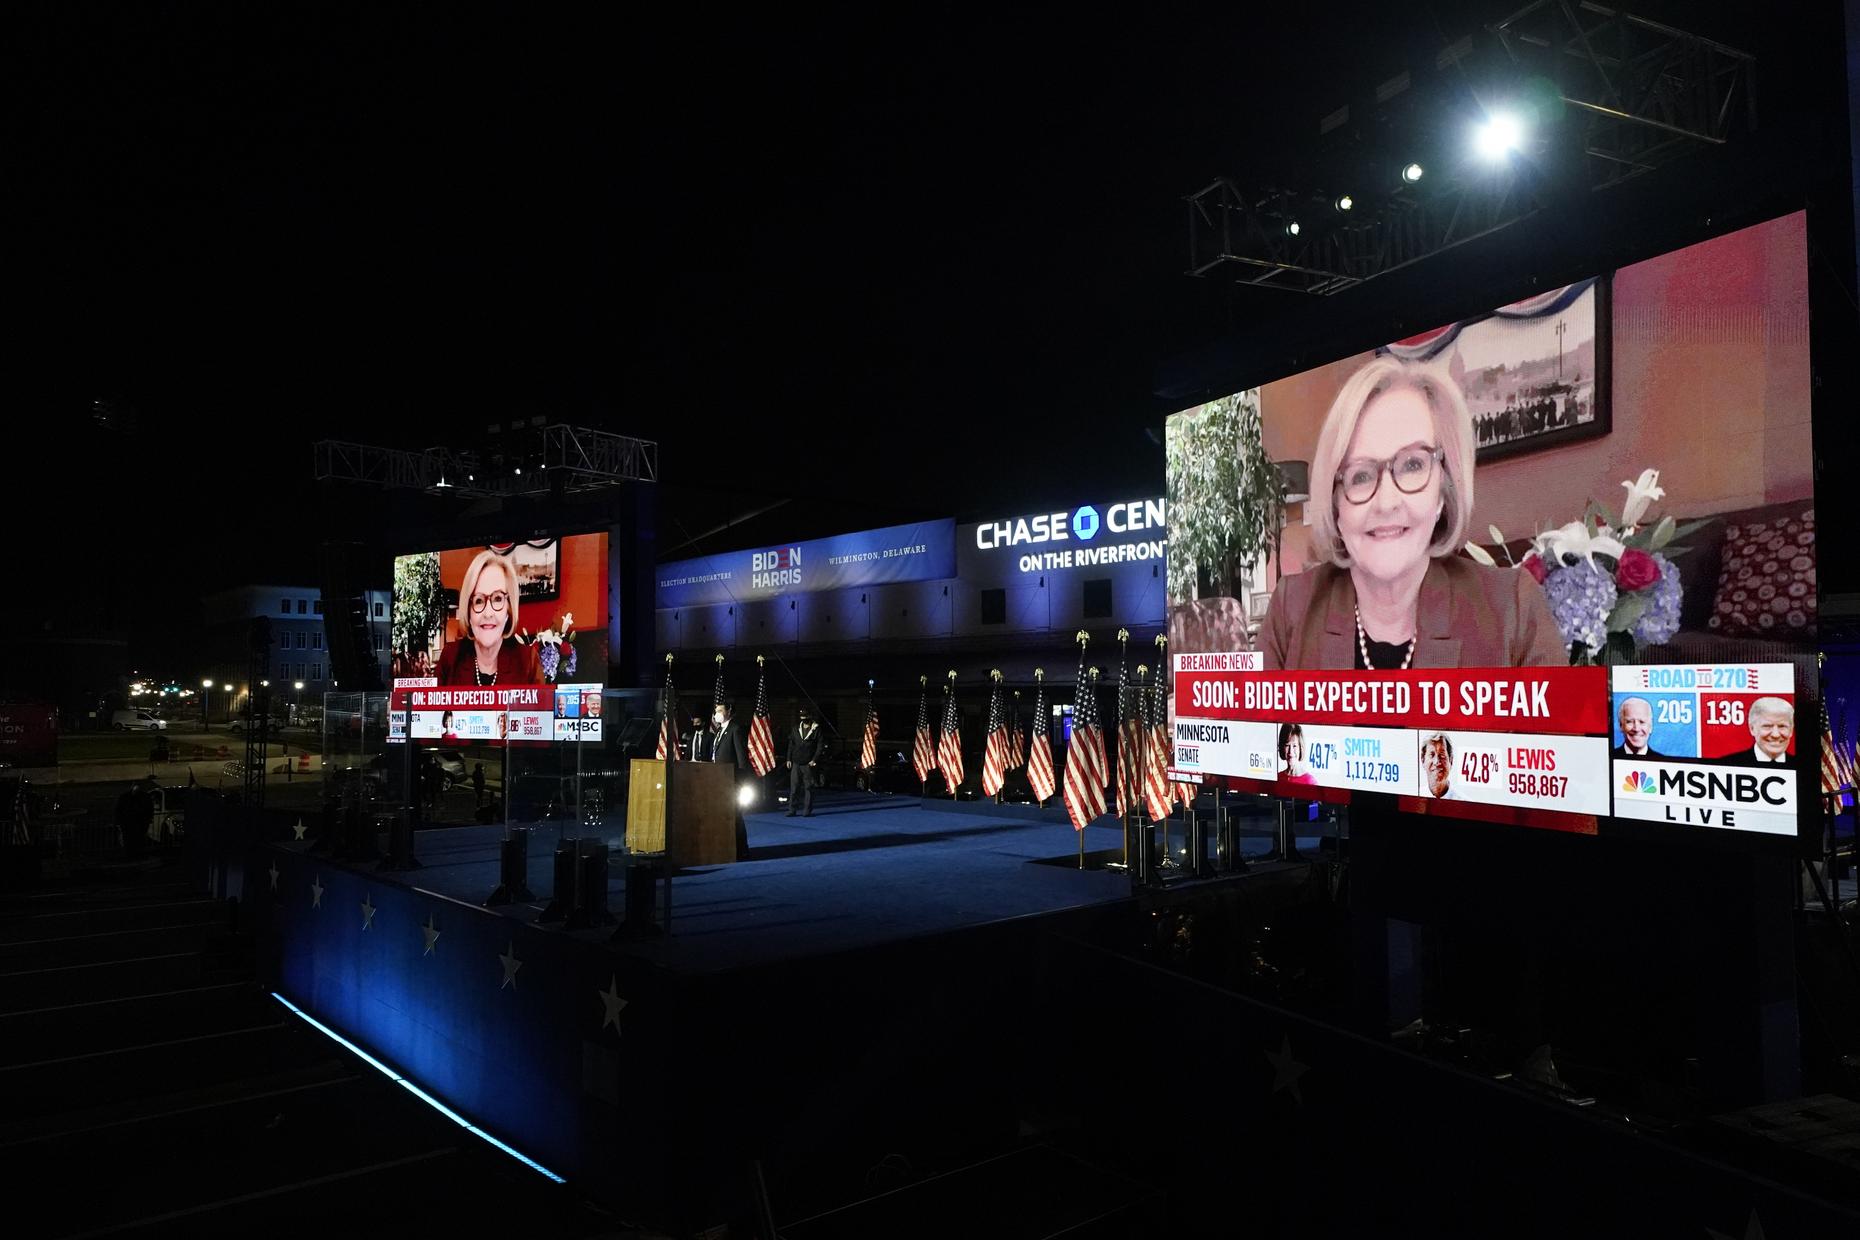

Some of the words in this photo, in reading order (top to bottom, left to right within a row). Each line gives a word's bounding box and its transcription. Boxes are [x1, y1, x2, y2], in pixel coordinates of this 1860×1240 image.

[976, 512, 1069, 550] CHASE
[1106, 498, 1168, 533] CEN
[752, 547, 801, 572] BIDEN
[828, 550, 881, 566] WILMINGTON,
[882, 544, 927, 559] DELAWARE
[1019, 553, 1043, 573] ON
[1043, 550, 1072, 570] THE
[1075, 540, 1168, 567] RIVERFRON
[660, 577, 687, 588] ELECTION
[687, 571, 732, 584] HEADQUARTERS
[752, 568, 802, 589] HARRIS
[1181, 655, 1228, 670] BREAKING
[1229, 653, 1254, 670] NEWS
[1649, 669, 1696, 688] ROAD
[1699, 672, 1712, 685] TO
[1713, 668, 1747, 688] 270
[427, 691, 452, 705] BIDEN
[453, 690, 495, 705] EXPECTED
[496, 690, 509, 704] TO
[1192, 680, 1239, 709] SOON:
[1244, 681, 1298, 710] BIDEN
[1303, 681, 1411, 714] EXPECTED
[1418, 681, 1450, 715] TO
[1459, 680, 1550, 717] SPEAK
[1657, 700, 1693, 724] 205
[1706, 700, 1745, 726] 136
[1176, 723, 1230, 744] MINNESOTA
[1177, 747, 1199, 764] SENATE
[1309, 742, 1338, 770] 49.7%
[1344, 737, 1382, 758] SMITH
[1461, 752, 1499, 784] 42.8%
[1507, 747, 1556, 772] LEWIS
[1346, 760, 1400, 783] 1,112,799
[1508, 772, 1568, 799] 958,867
[1659, 769, 1788, 806] MSNBC
[1665, 805, 1736, 827] LIVE
